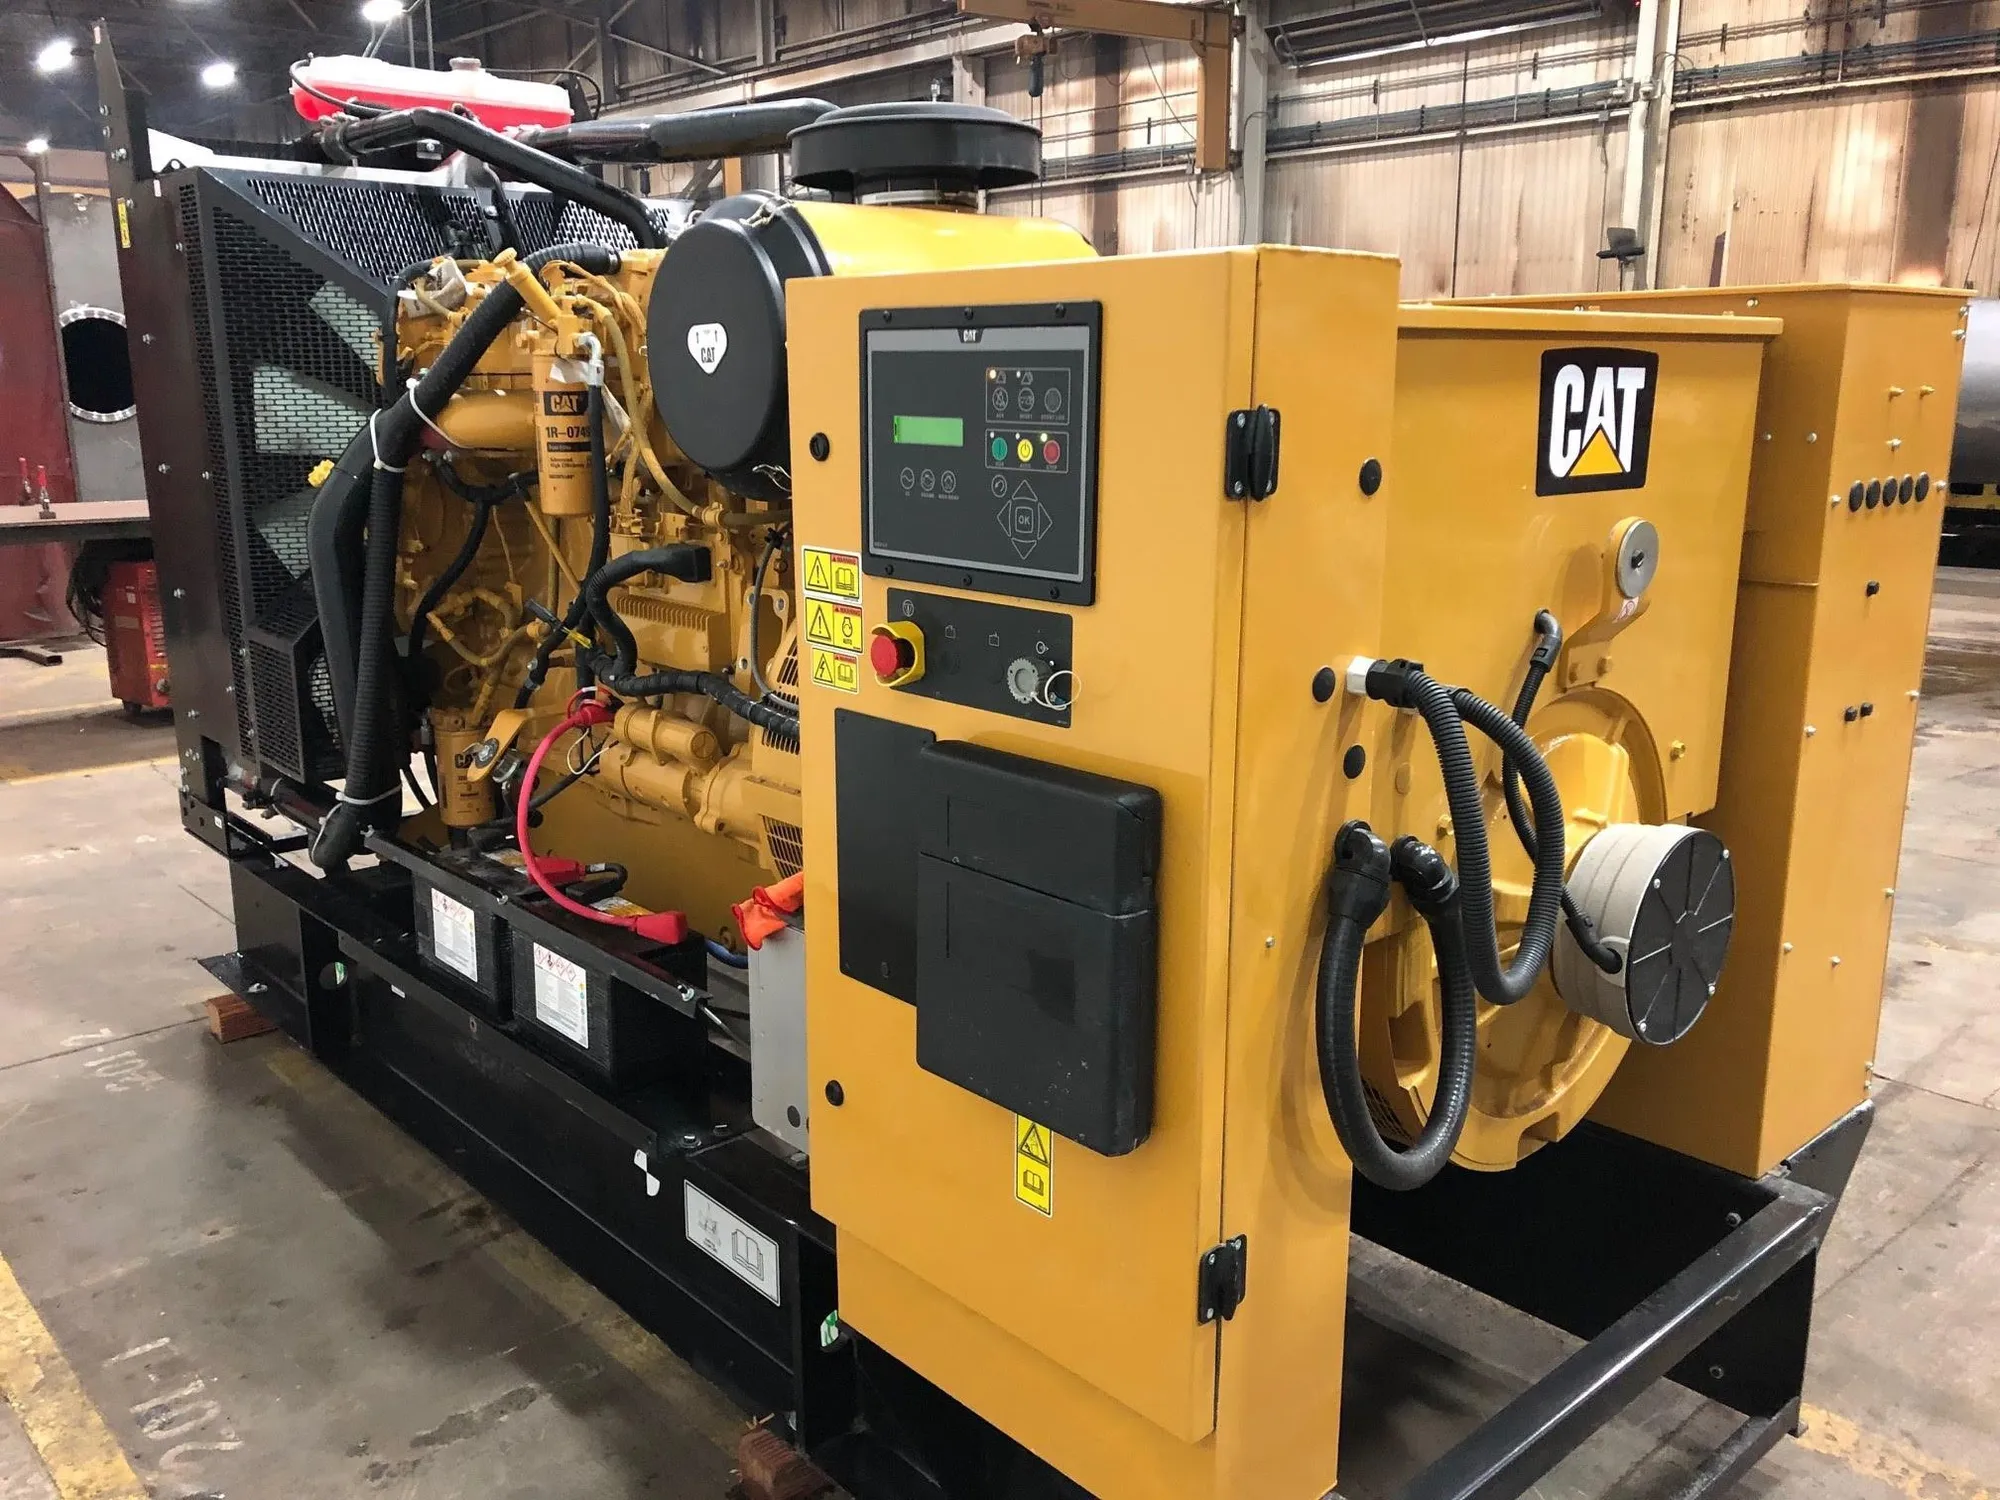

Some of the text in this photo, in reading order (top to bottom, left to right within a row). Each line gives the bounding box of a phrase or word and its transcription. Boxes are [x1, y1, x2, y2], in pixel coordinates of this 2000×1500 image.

[963, 329, 977, 342] CAT
[700, 346, 716, 363] CAT
[550, 394, 579, 413] CAT
[1549, 363, 1647, 478] CAT
[1018, 515, 1031, 526] OK
